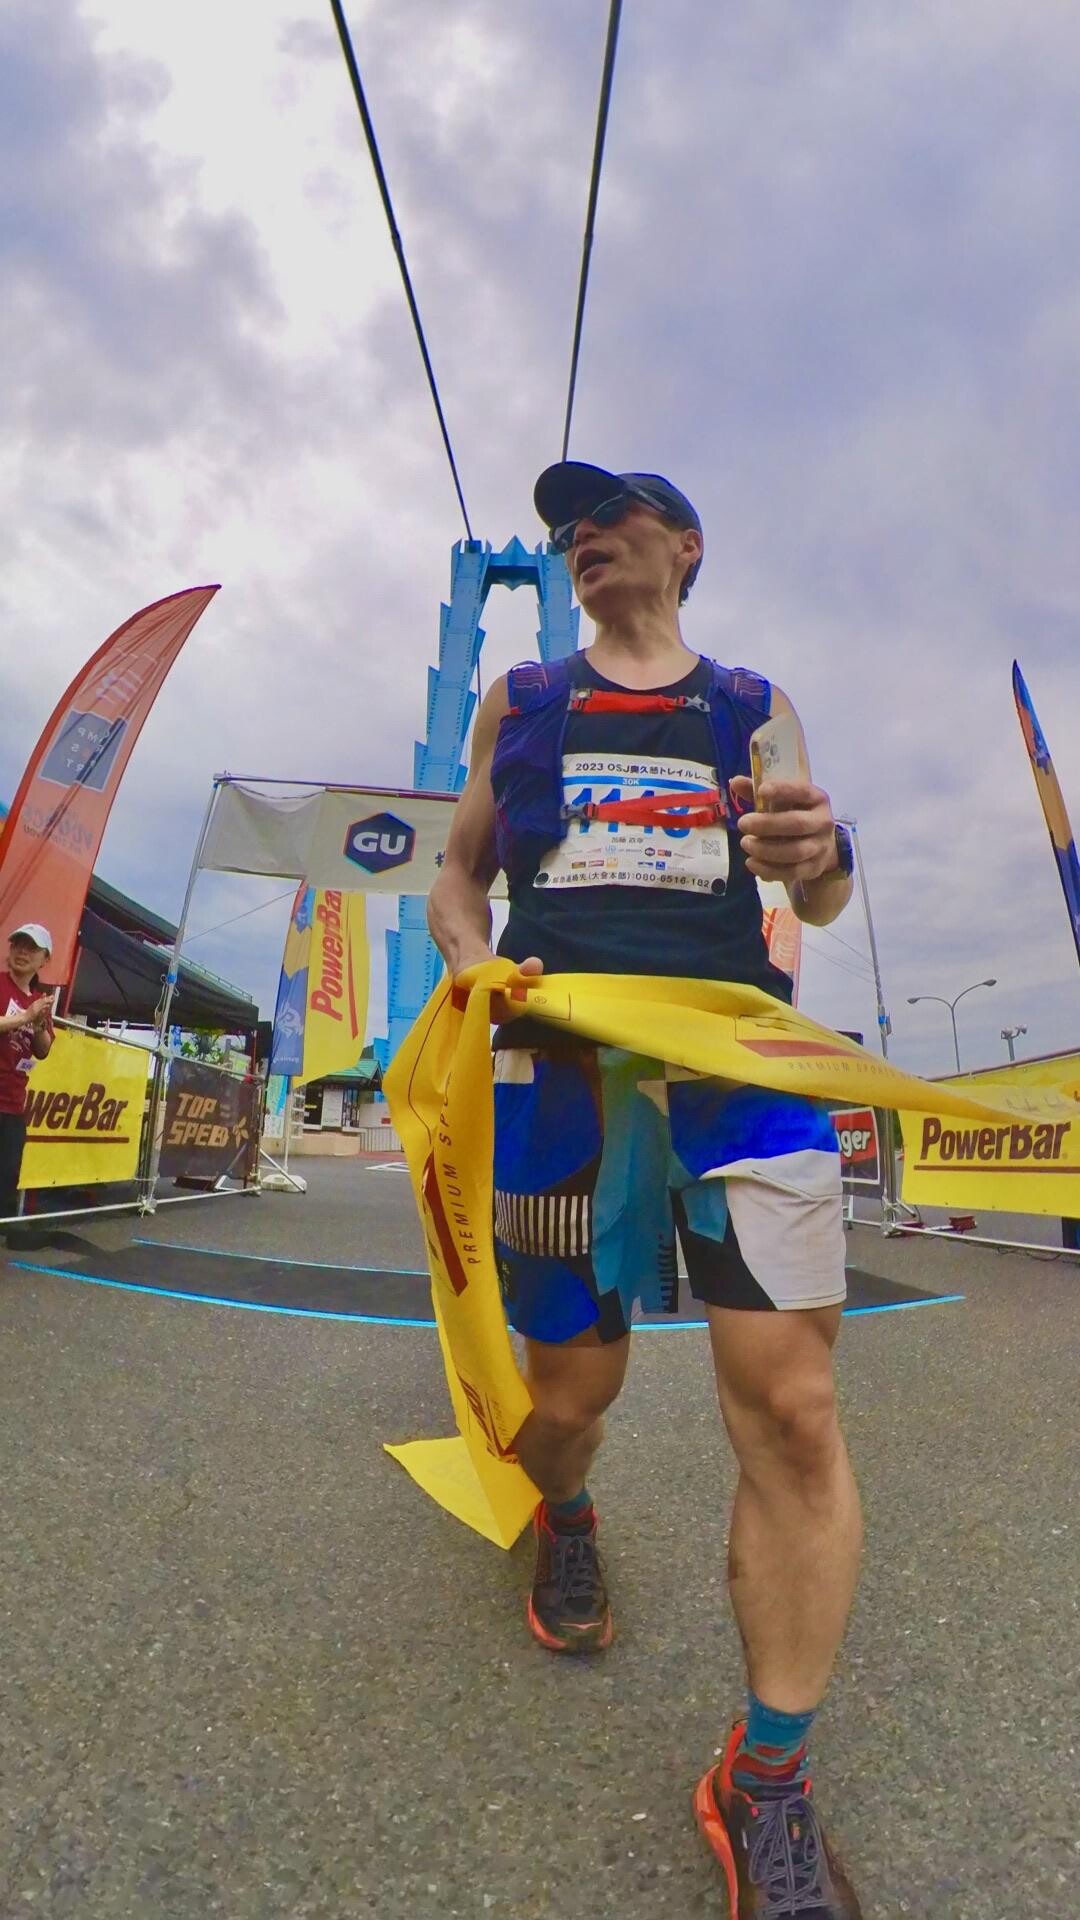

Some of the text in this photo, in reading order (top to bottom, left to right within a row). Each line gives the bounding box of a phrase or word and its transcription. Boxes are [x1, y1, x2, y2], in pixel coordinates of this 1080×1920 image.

[575, 762, 604, 772] 2023
[622, 778, 640, 786] 30K
[353, 831, 407, 856] GU
[311, 889, 344, 1022] PowerBa
[176, 1092, 218, 1120] TOP
[920, 1117, 1072, 1161] PowerBar
[441, 1161, 481, 1265] PREMIUM
